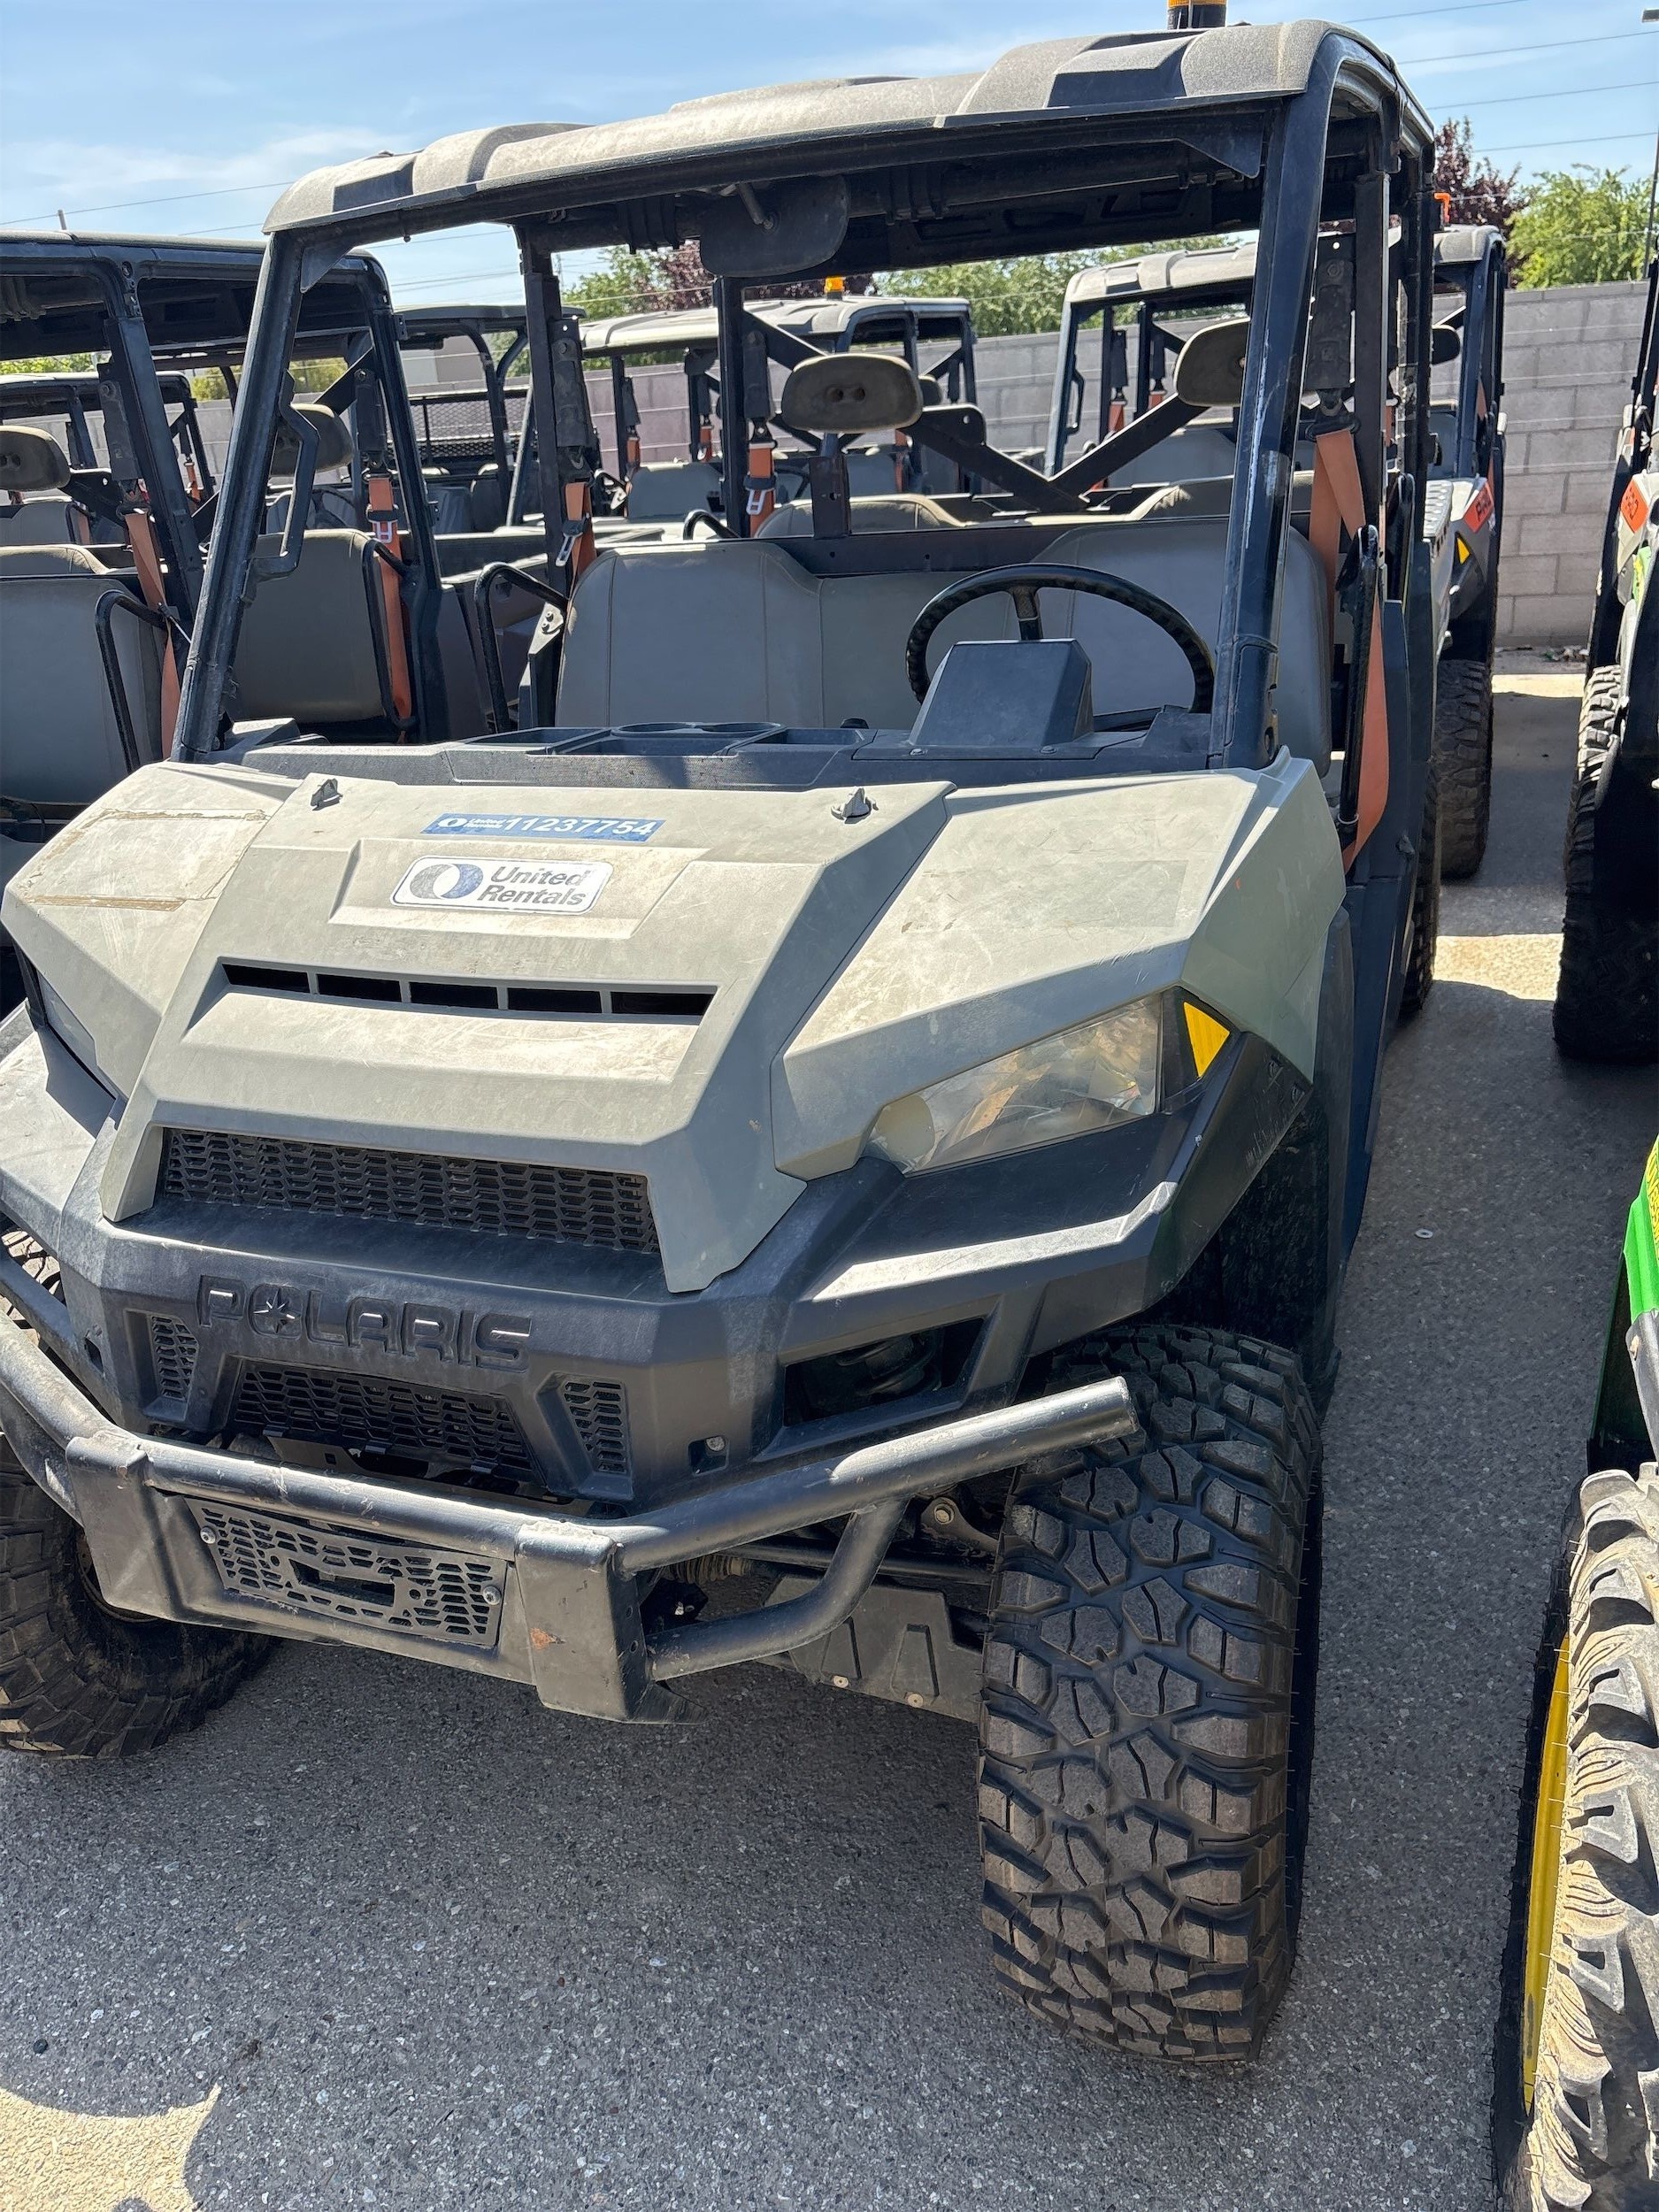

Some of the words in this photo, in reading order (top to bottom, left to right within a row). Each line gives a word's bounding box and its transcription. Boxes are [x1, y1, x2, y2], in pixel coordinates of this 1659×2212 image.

[503, 817, 657, 835] 11237754
[490, 865, 591, 886] United
[477, 885, 586, 906] Rentals
[196, 1274, 532, 1374] POLARIS
